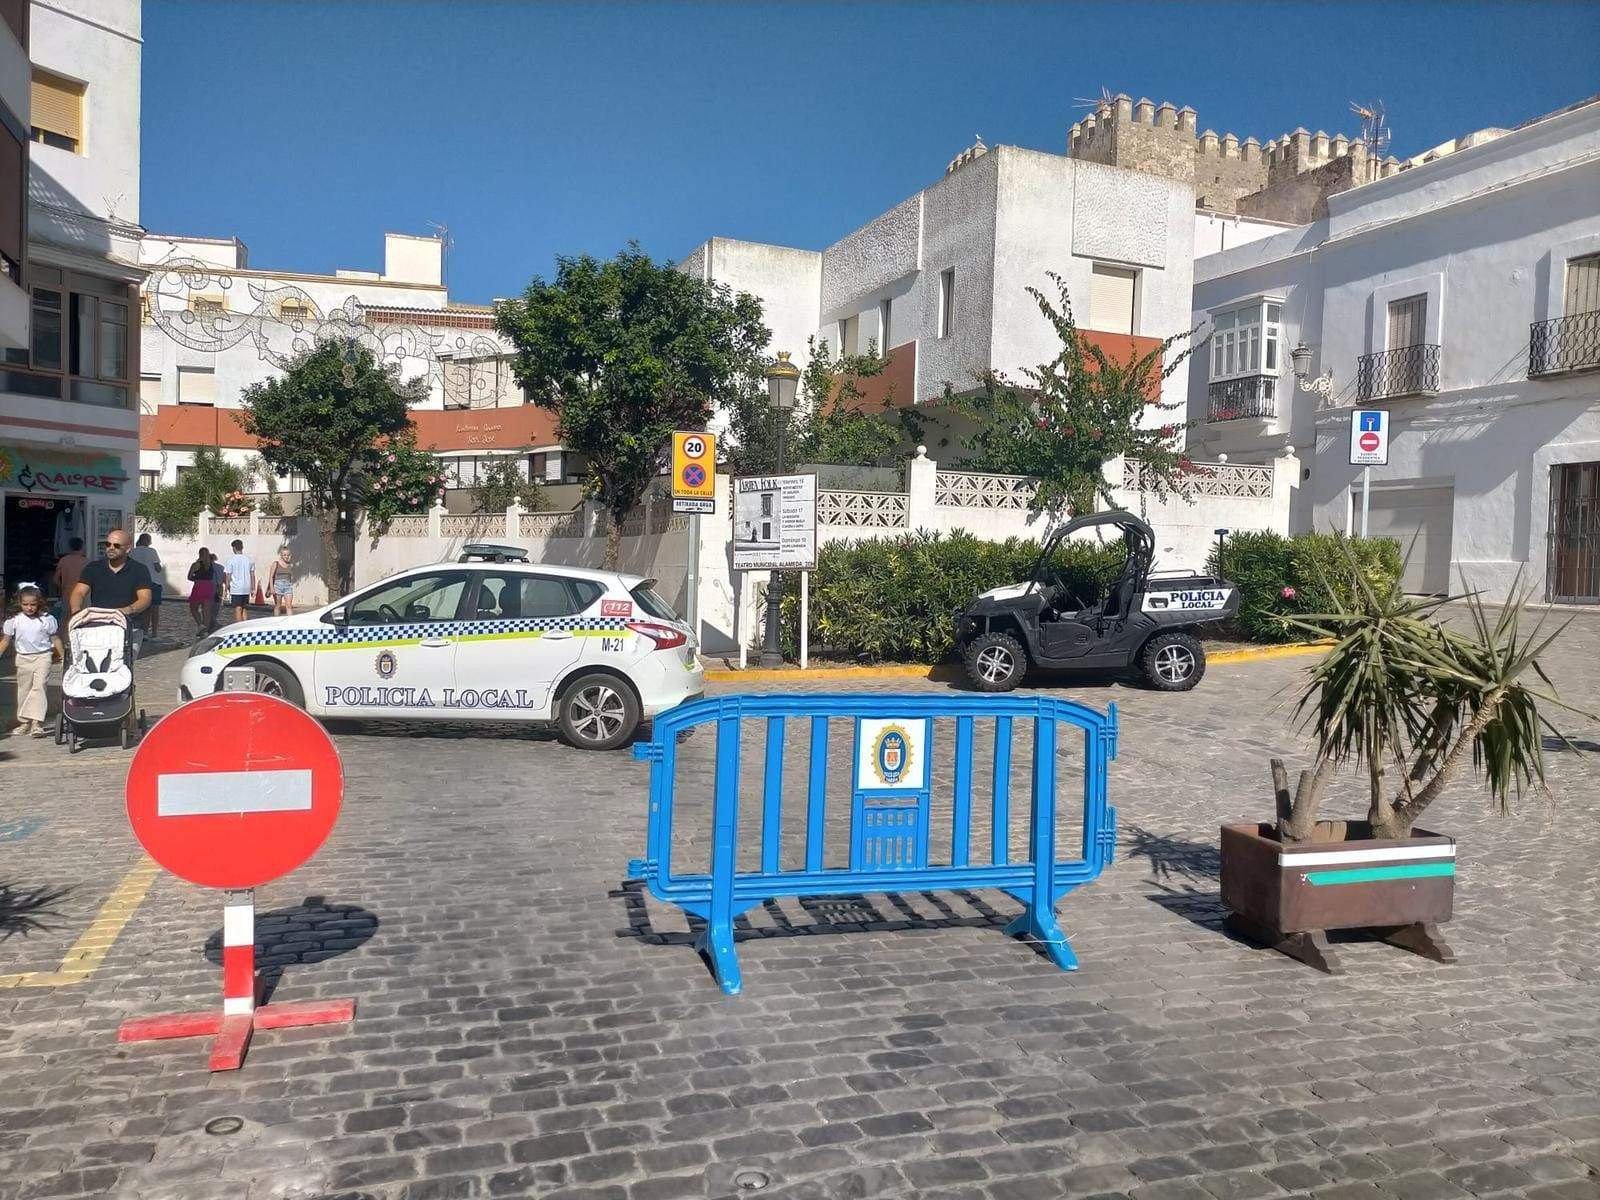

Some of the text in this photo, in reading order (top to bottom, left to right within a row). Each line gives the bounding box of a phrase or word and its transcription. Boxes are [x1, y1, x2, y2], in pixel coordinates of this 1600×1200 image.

[687, 442, 702, 453] 20
[1170, 591, 1225, 602] POLICIA
[1181, 601, 1214, 609] LOCAL
[602, 638, 624, 652] M-21
[325, 686, 534, 709] POLICIA LOCAL
